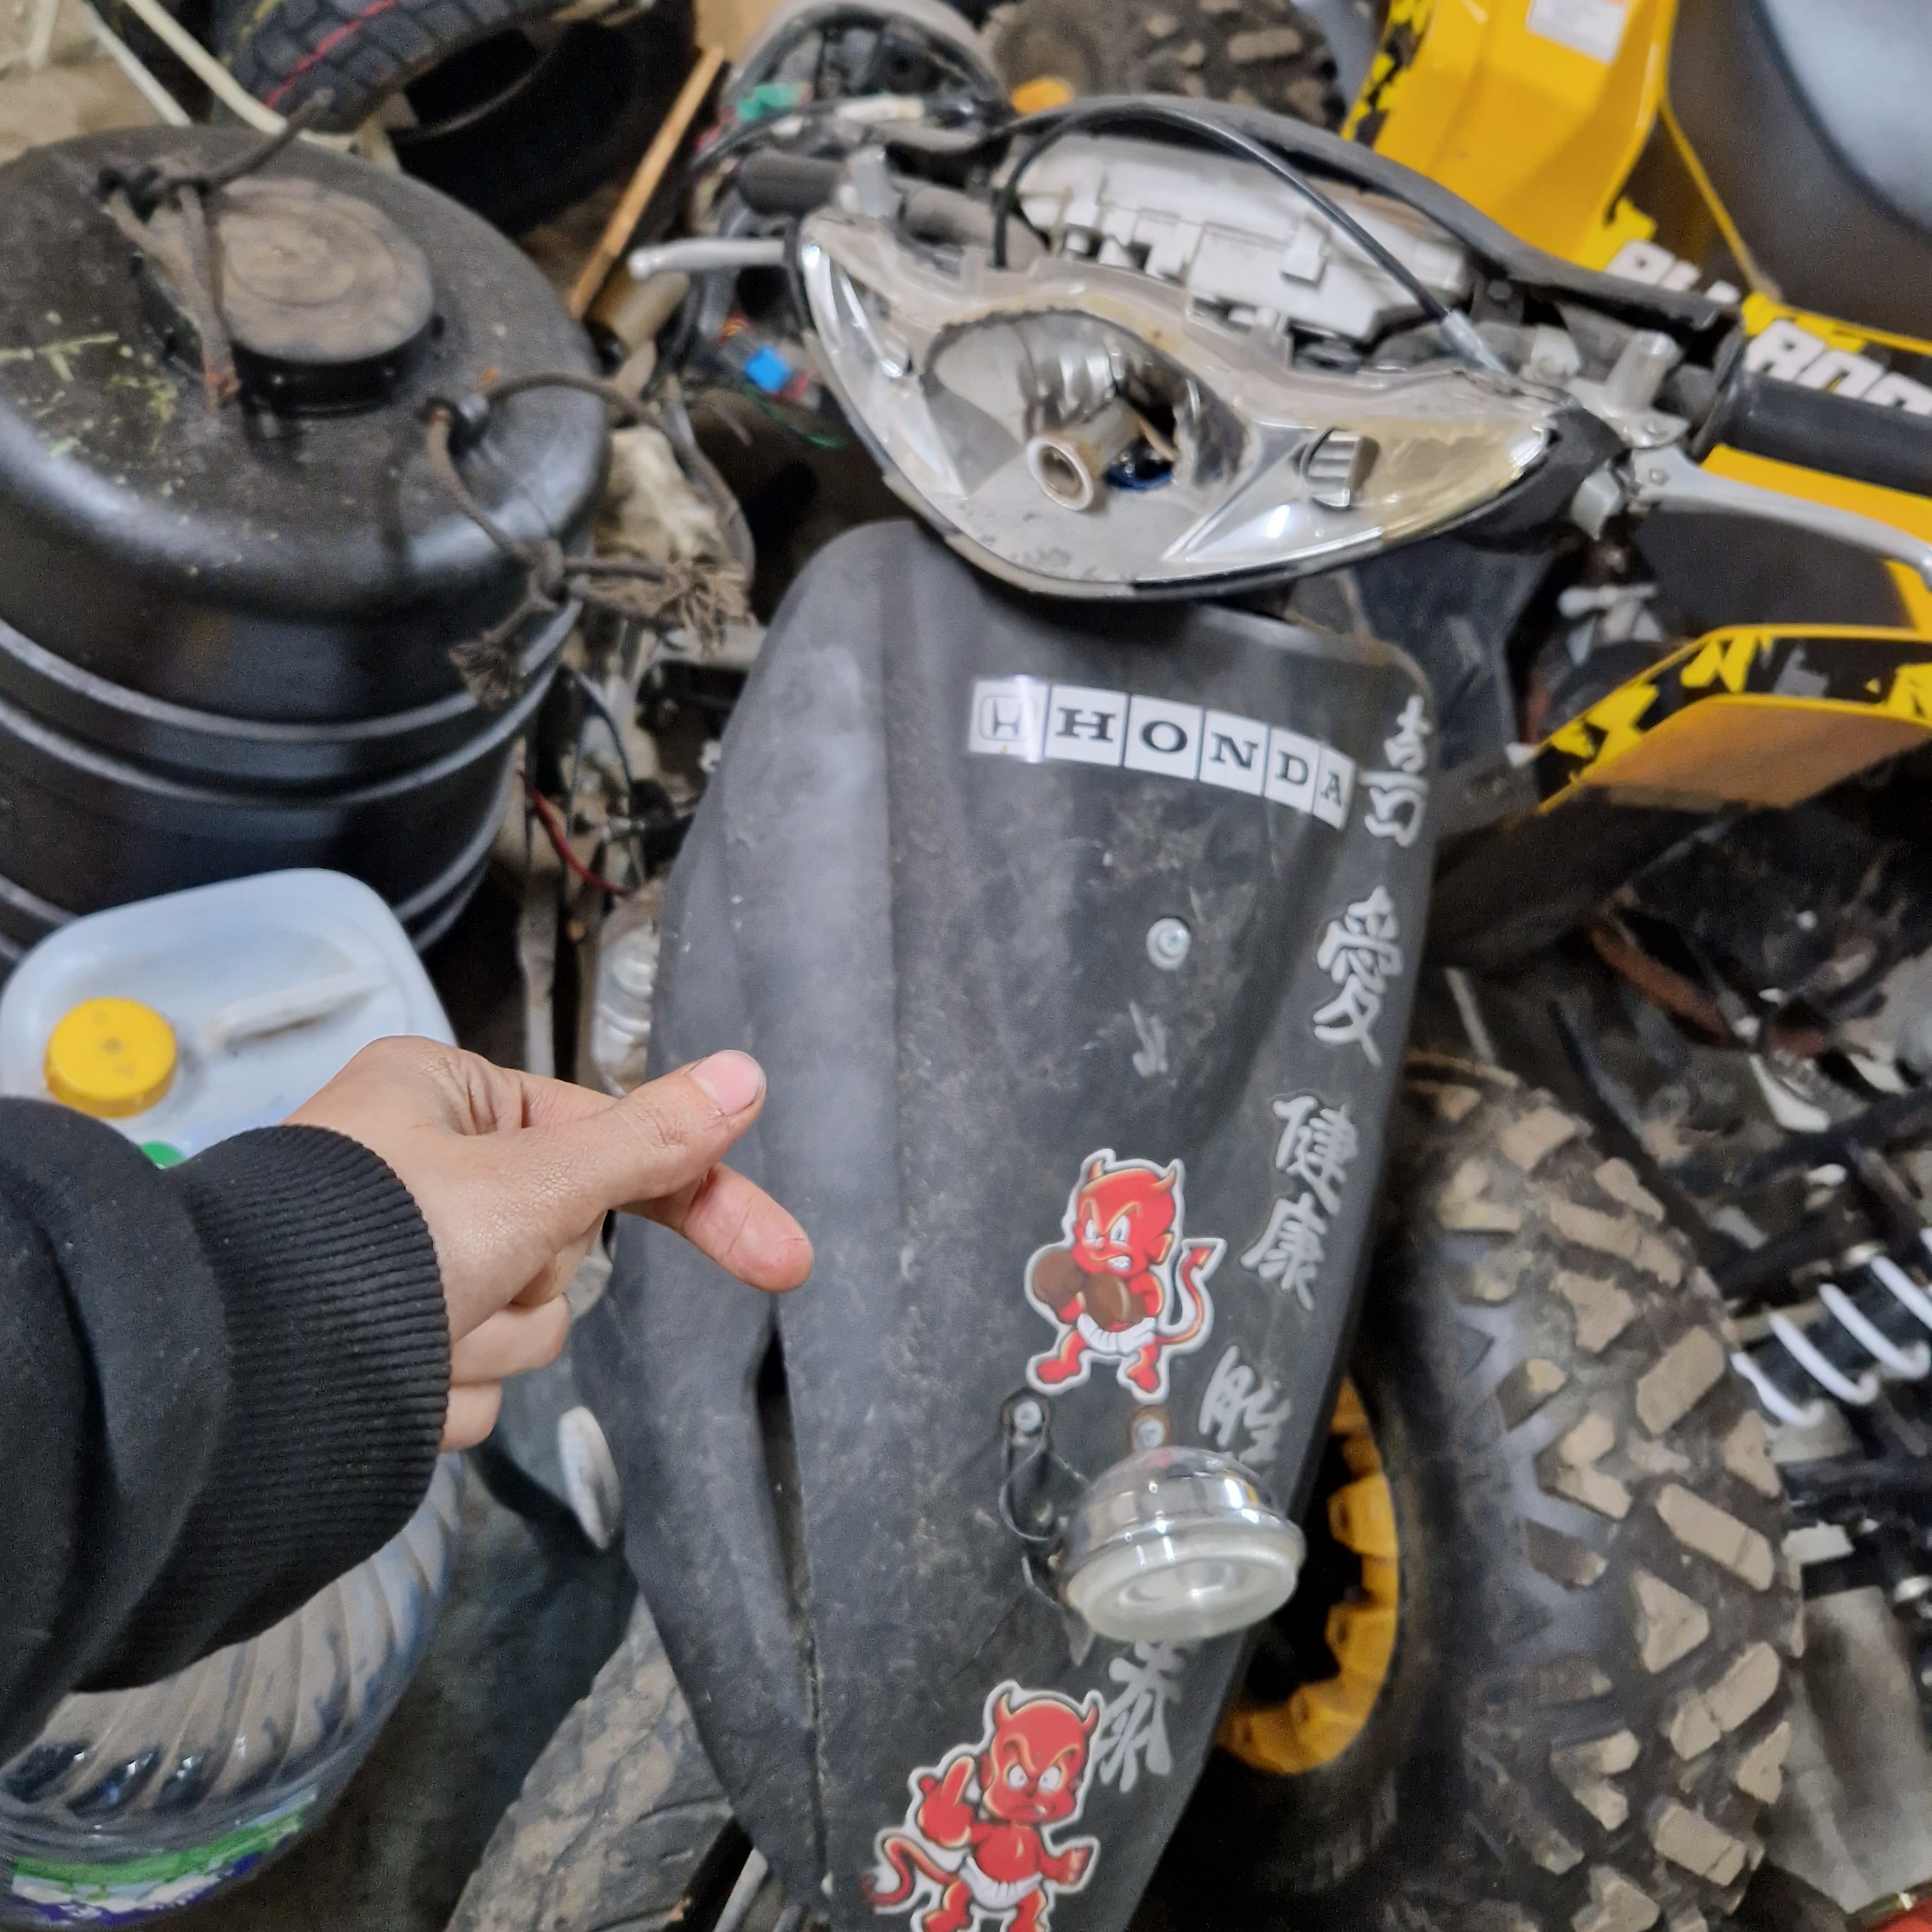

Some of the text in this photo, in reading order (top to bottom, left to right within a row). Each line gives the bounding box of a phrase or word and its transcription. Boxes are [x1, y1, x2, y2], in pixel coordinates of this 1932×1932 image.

[1054, 706, 1343, 808] HONDA
[1312, 884, 1403, 1068] 愛
[1240, 1095, 1358, 1312] 健康
